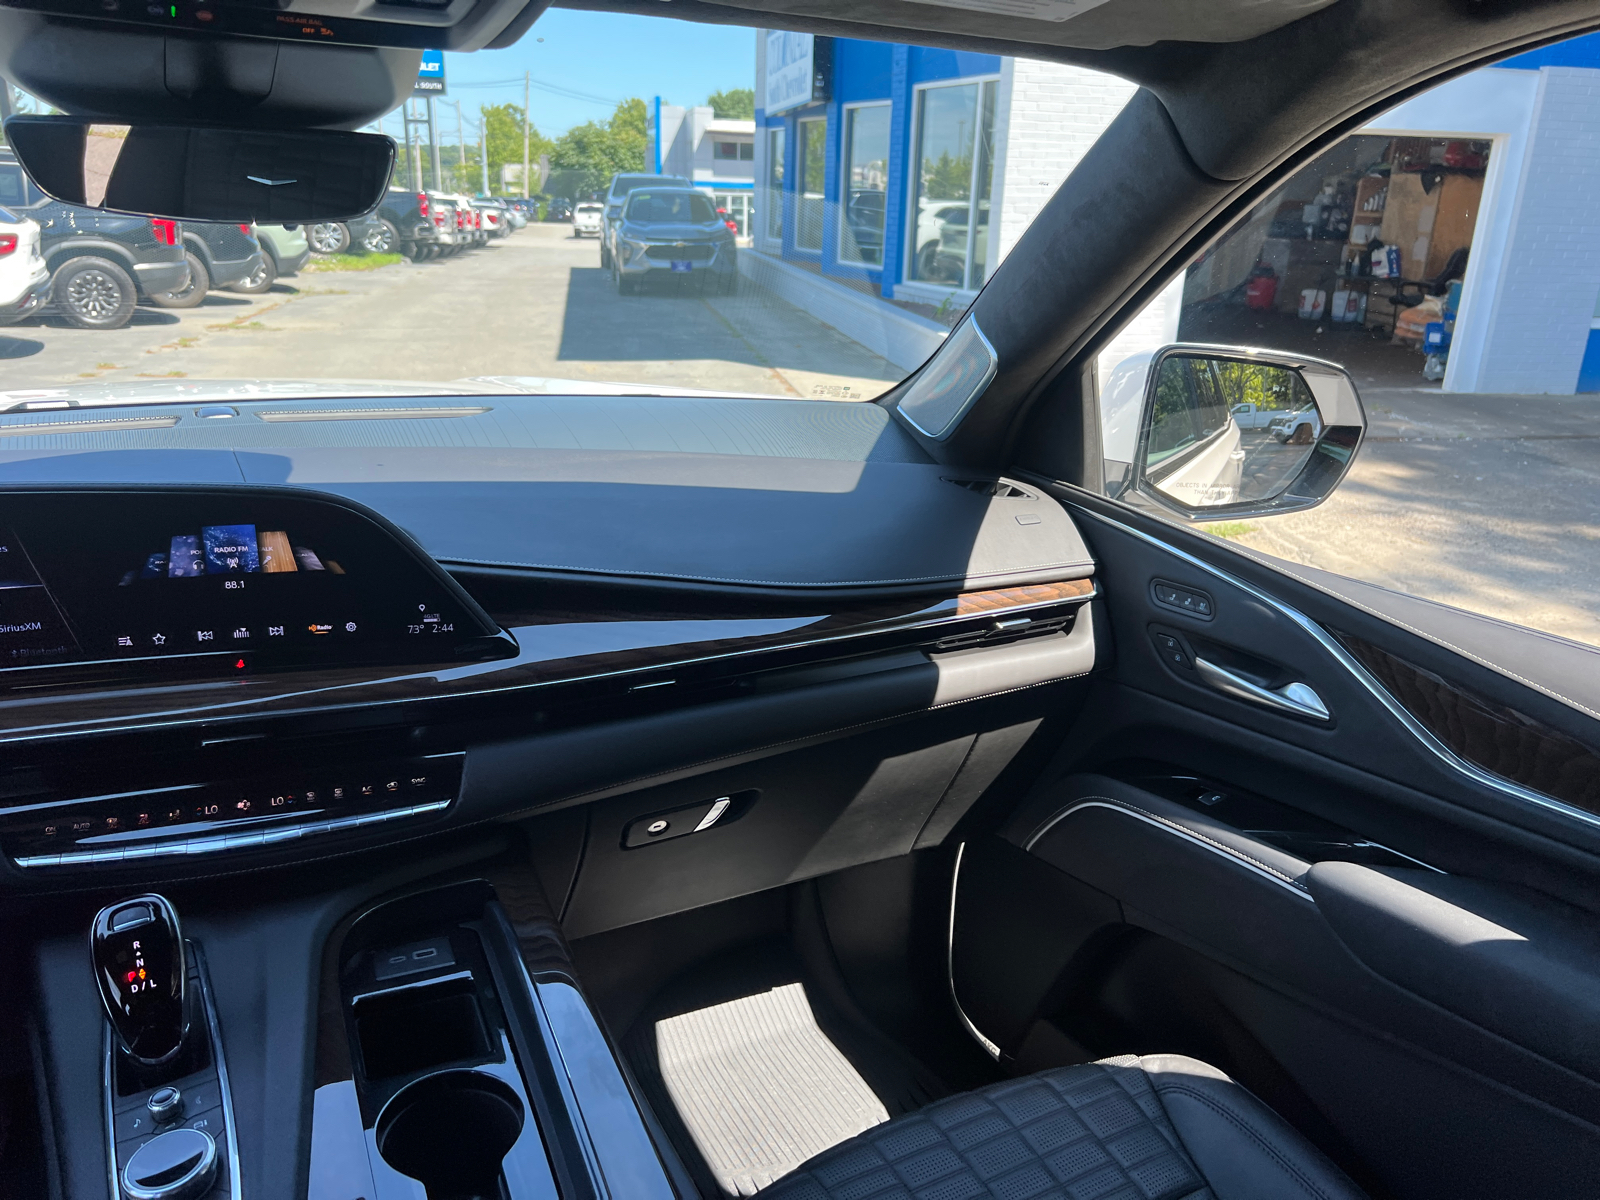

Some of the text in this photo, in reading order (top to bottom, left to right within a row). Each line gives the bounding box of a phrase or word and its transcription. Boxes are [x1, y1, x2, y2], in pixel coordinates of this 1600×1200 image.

[225, 580, 245, 589] 88.1
[0, 621, 42, 633] SiriusXM
[407, 623, 454, 634] 73° 2:44
[271, 796, 284, 806] LO
[205, 804, 218, 815] LO
[133, 941, 140, 949] R
[136, 958, 144, 967] N
